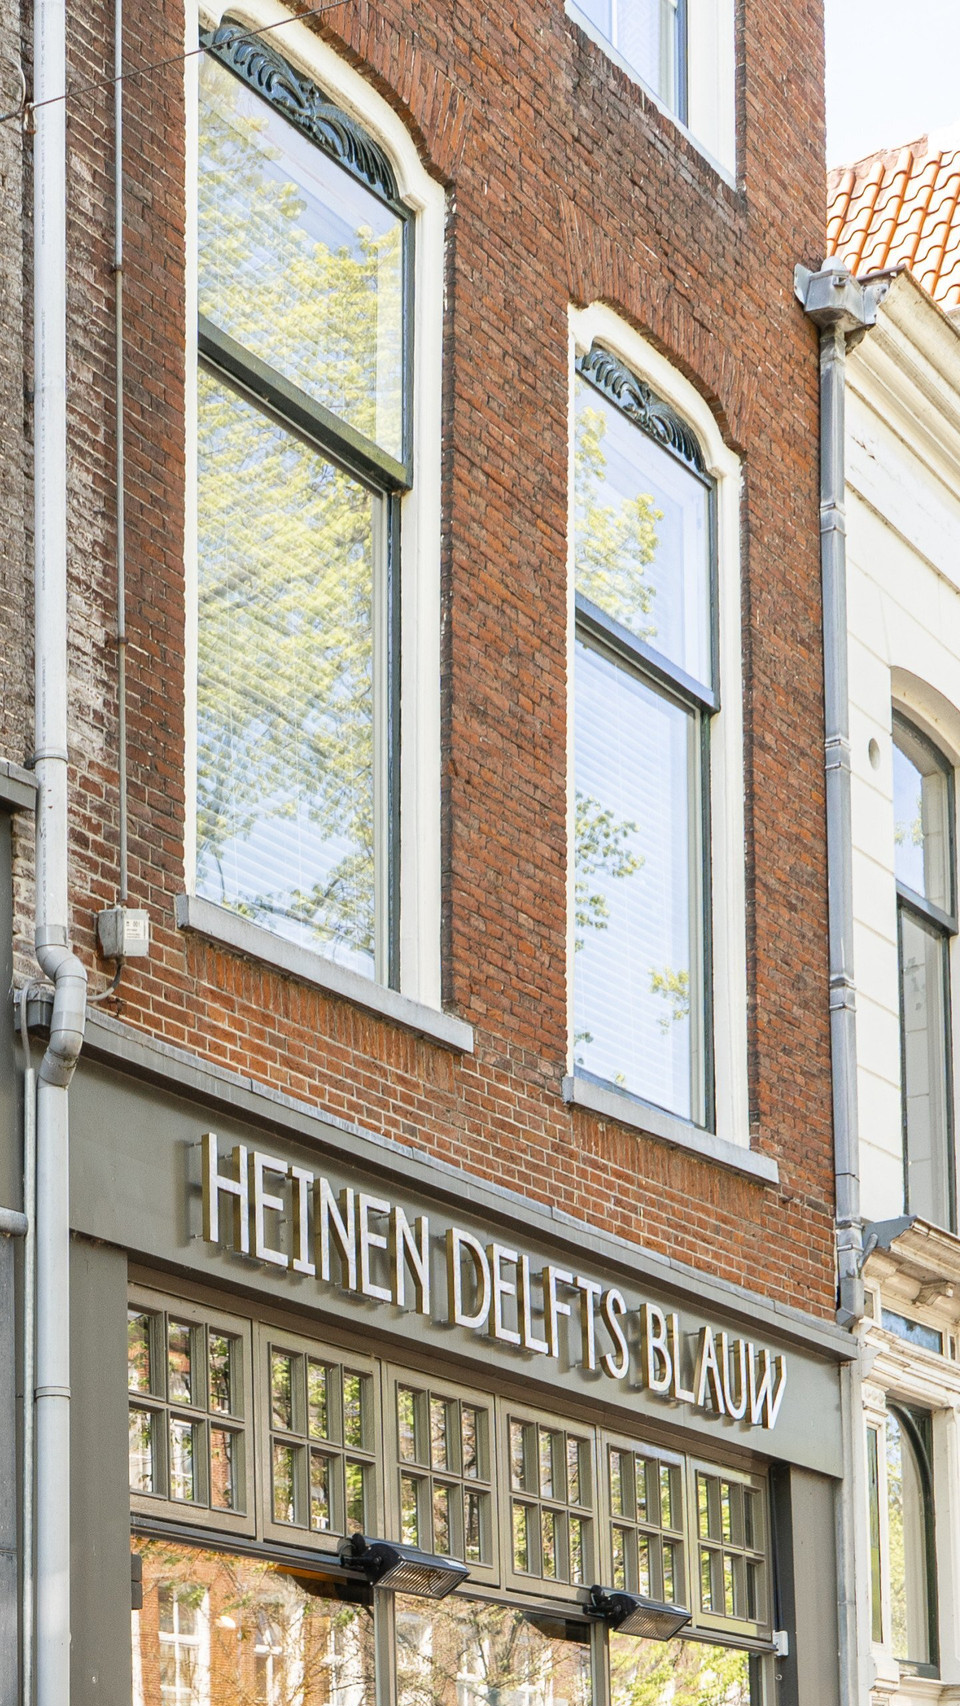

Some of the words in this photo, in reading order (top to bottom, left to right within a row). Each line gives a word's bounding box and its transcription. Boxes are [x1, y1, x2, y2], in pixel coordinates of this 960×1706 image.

[200, 1132, 430, 1315] HEINEN
[446, 1228, 629, 1380] DELFTS
[641, 1302, 787, 1430] BLAUW
